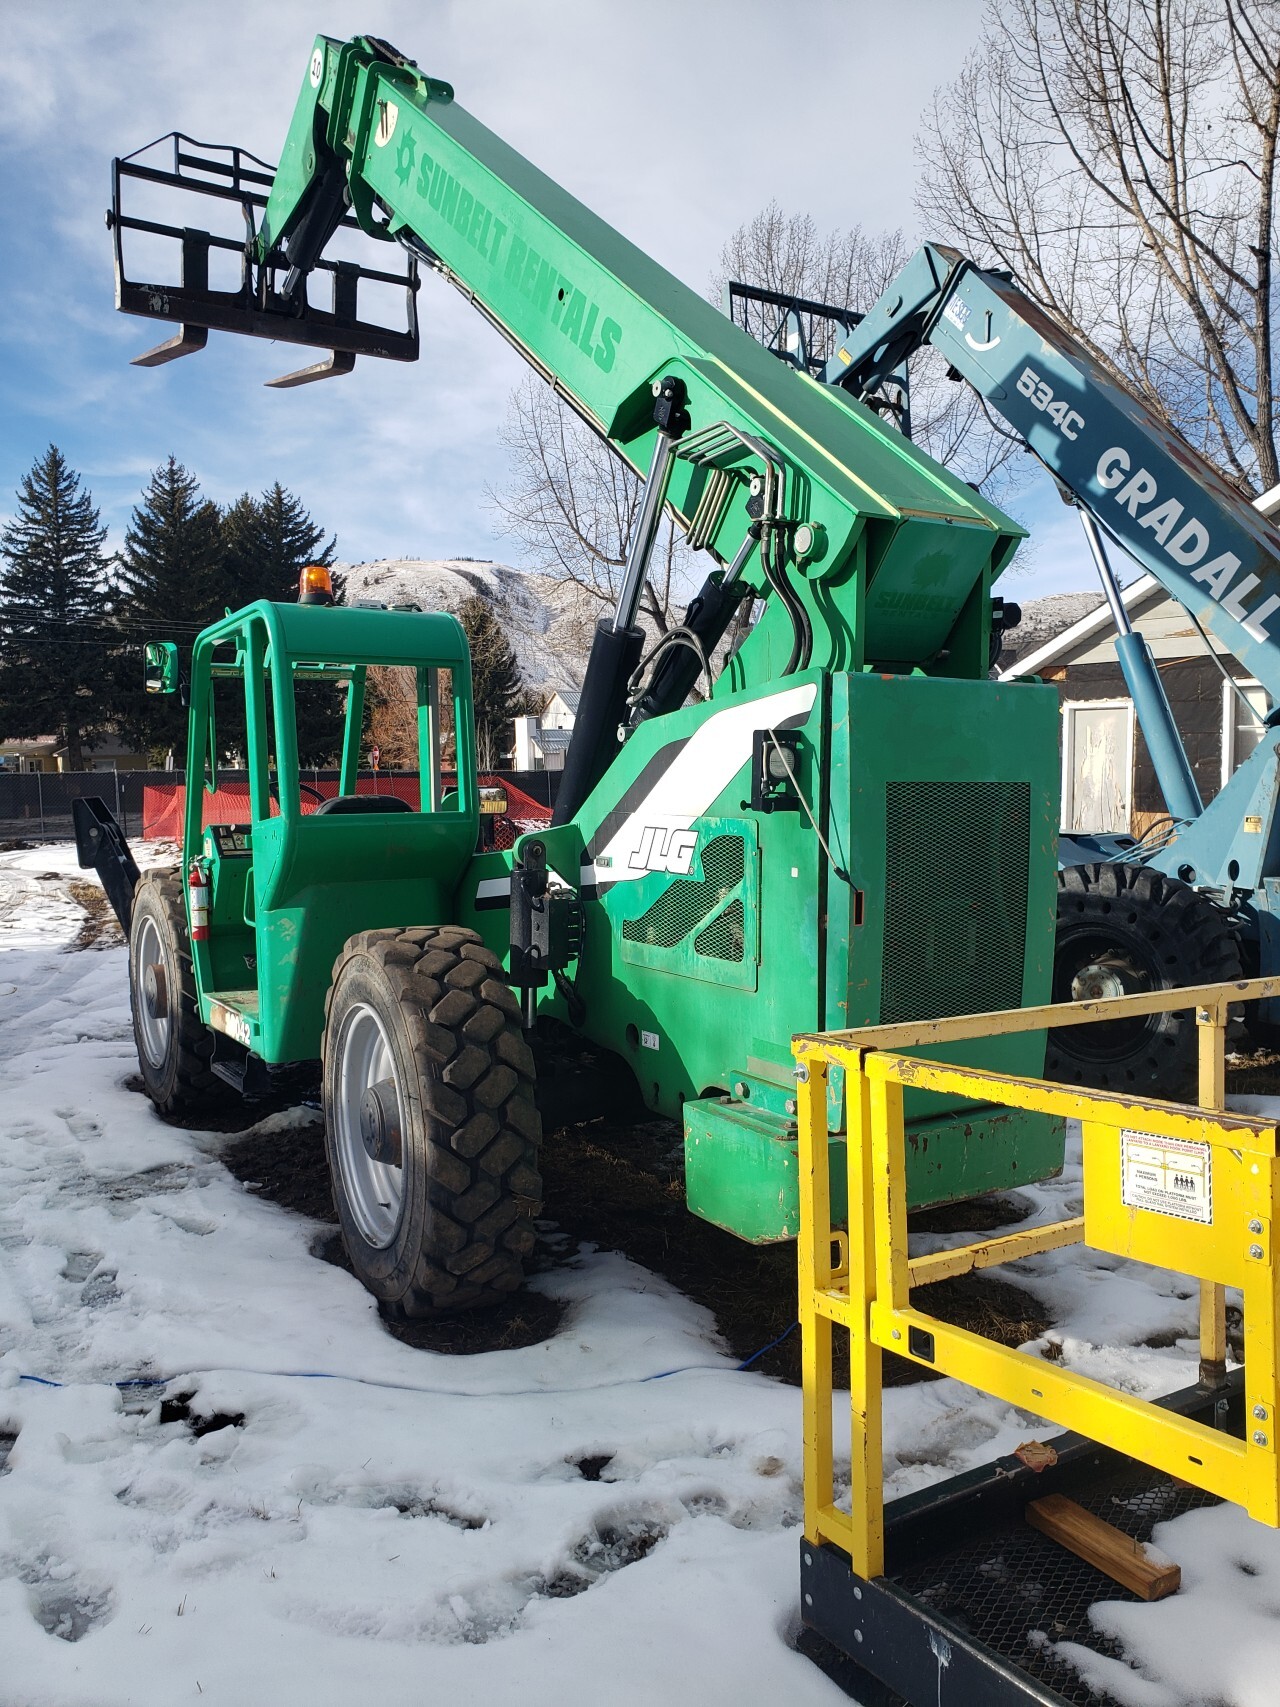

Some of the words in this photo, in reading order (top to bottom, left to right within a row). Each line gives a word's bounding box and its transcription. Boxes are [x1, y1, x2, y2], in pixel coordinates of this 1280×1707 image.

[312, 58, 321, 79] 10
[416, 152, 507, 266] SUNBELT
[500, 230, 622, 373] RENTALS
[1016, 367, 1085, 441] 534C
[1096, 446, 1280, 644] GRADALL
[628, 826, 699, 876] JLG
